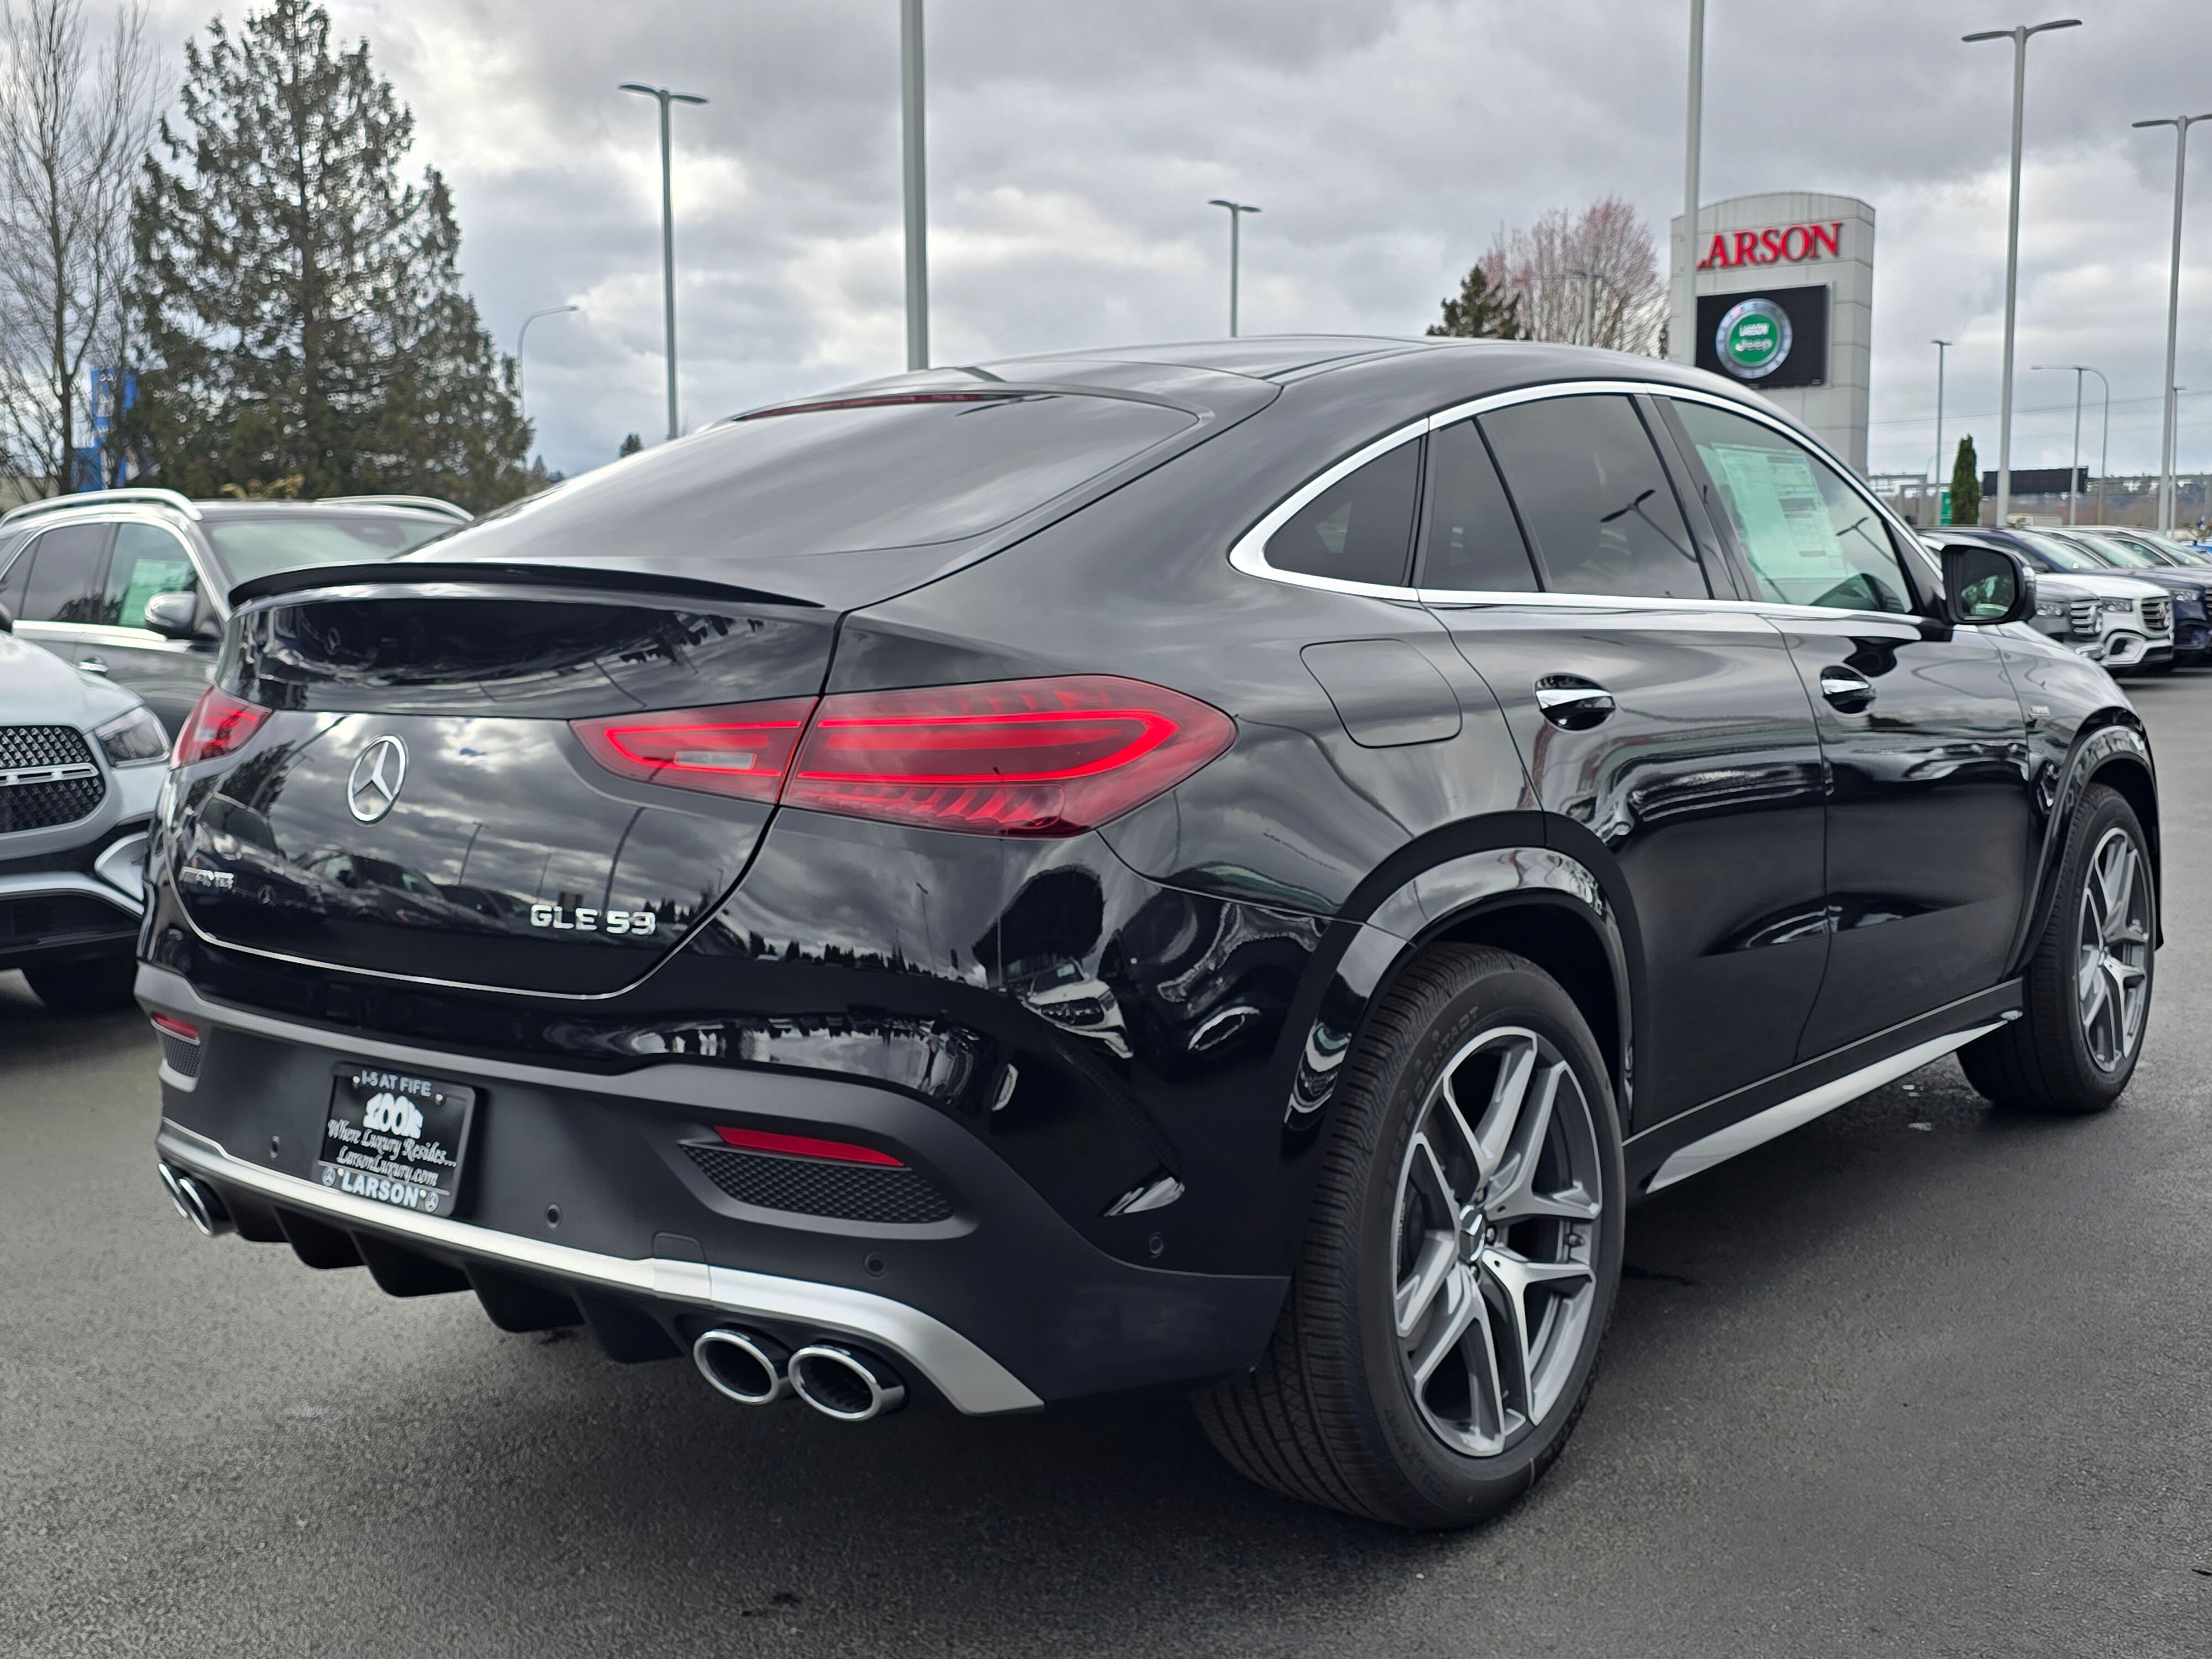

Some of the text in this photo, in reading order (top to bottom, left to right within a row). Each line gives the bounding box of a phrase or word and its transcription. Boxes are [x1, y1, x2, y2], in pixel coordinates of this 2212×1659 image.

[1696, 222, 1843, 270] ARSON
[530, 904, 598, 931] GLE
[361, 1070, 432, 1097] I-5 AT FIFE
[327, 1119, 362, 1144] Where
[361, 1129, 402, 1161] Luxury
[341, 1171, 419, 1208] LARSON
